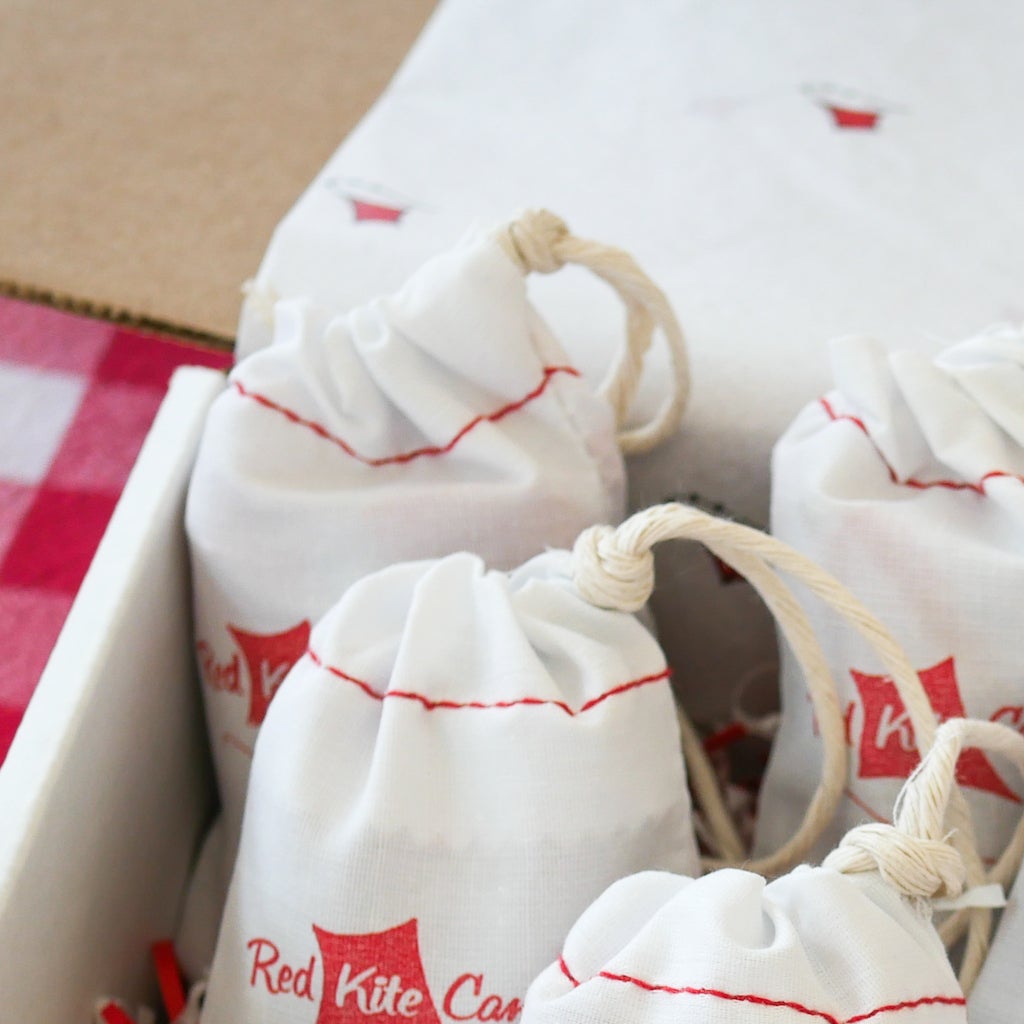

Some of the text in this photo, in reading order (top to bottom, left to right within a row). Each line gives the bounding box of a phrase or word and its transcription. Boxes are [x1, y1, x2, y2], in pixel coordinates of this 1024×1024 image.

[248, 938, 522, 1022] Red Kite Can
